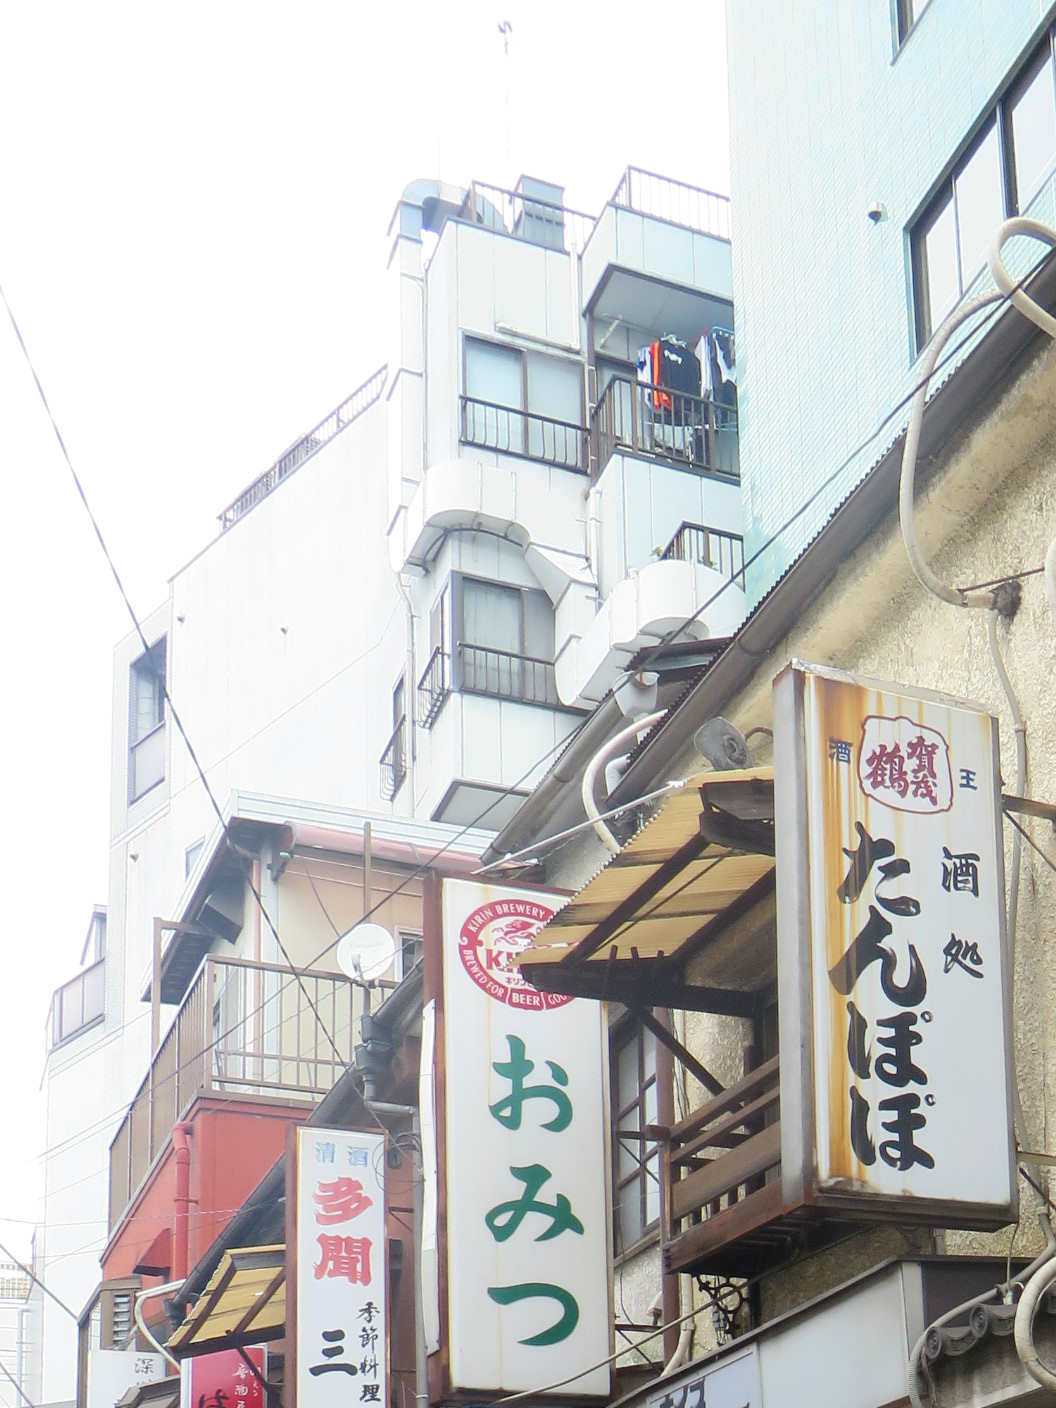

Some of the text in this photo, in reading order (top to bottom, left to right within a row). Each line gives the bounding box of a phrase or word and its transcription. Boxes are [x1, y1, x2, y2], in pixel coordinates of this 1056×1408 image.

[829, 736, 978, 791] 酒 王
[467, 903, 546, 933] KIRIN BREWERY
[942, 846, 984, 979] 酒処
[463, 949, 487, 985] BREWED
[486, 982, 505, 999] FOR
[512, 992, 541, 1006] BEER
[829, 821, 936, 1171] たんぽぽ
[315, 1141, 368, 1167] 清酒
[485, 1034, 584, 1346] おみつ
[356, 1301, 382, 1403] 季節料理
